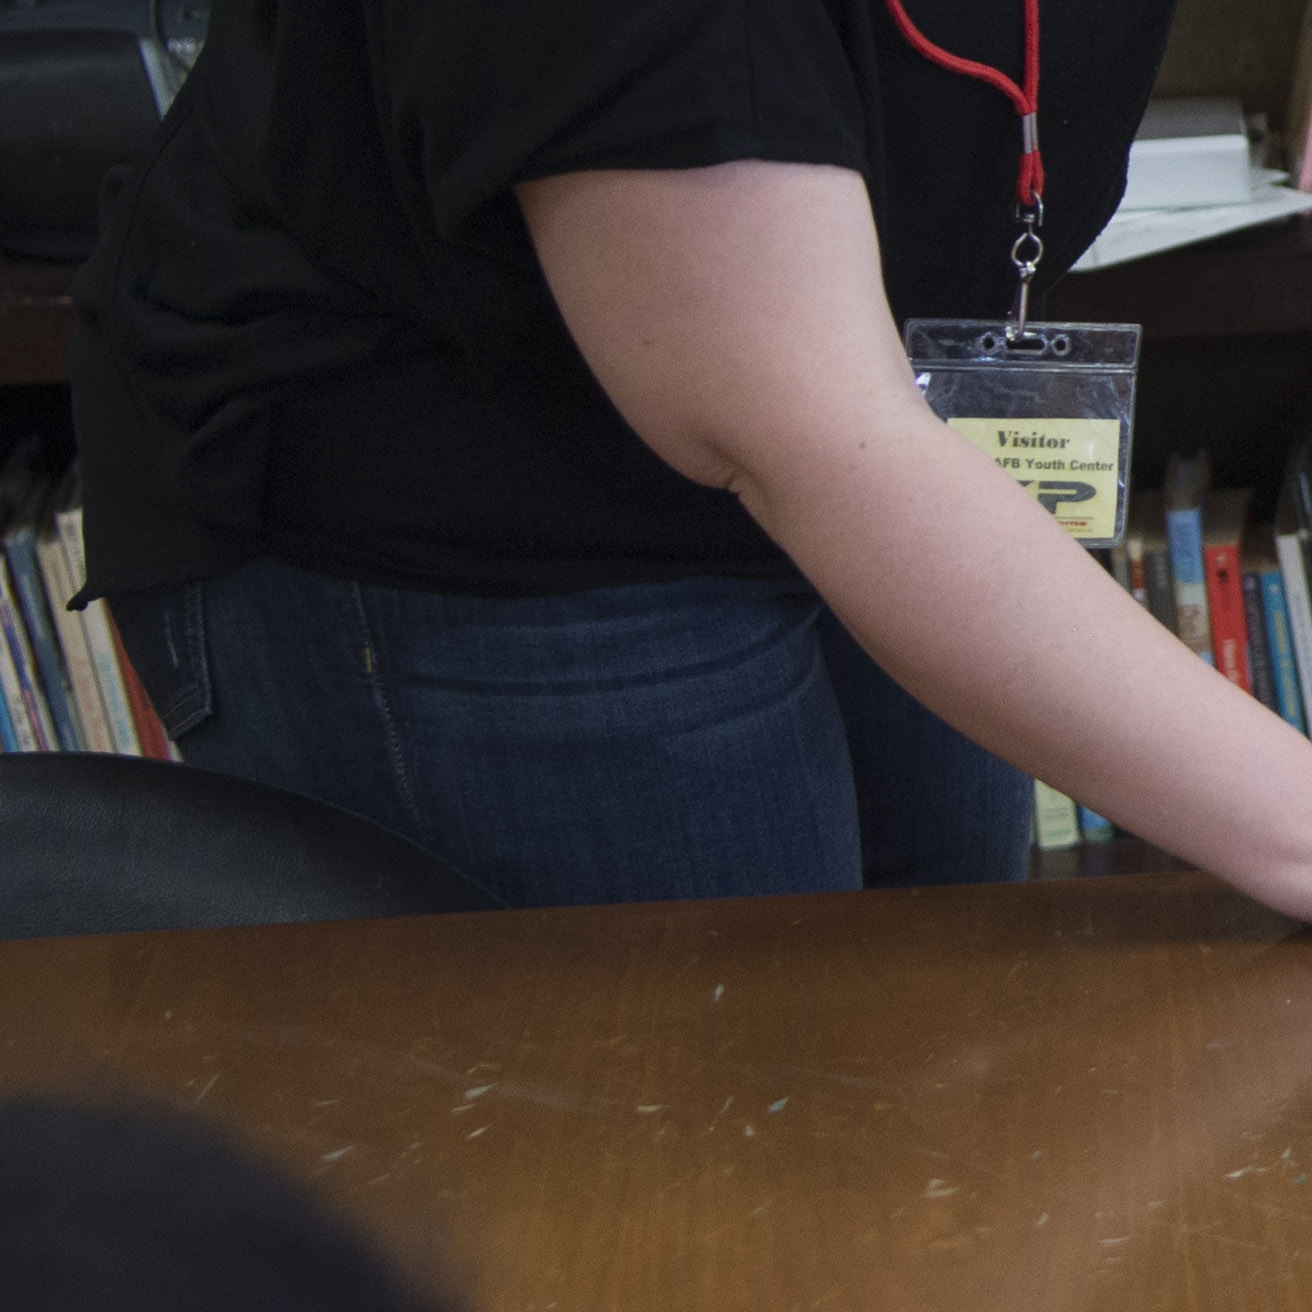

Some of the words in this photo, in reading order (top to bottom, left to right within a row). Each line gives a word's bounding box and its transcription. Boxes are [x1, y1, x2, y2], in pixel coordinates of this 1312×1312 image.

[997, 430, 1070, 449] Visitor
[1026, 458, 1065, 470] Youth
[1070, 460, 1114, 472] Center
